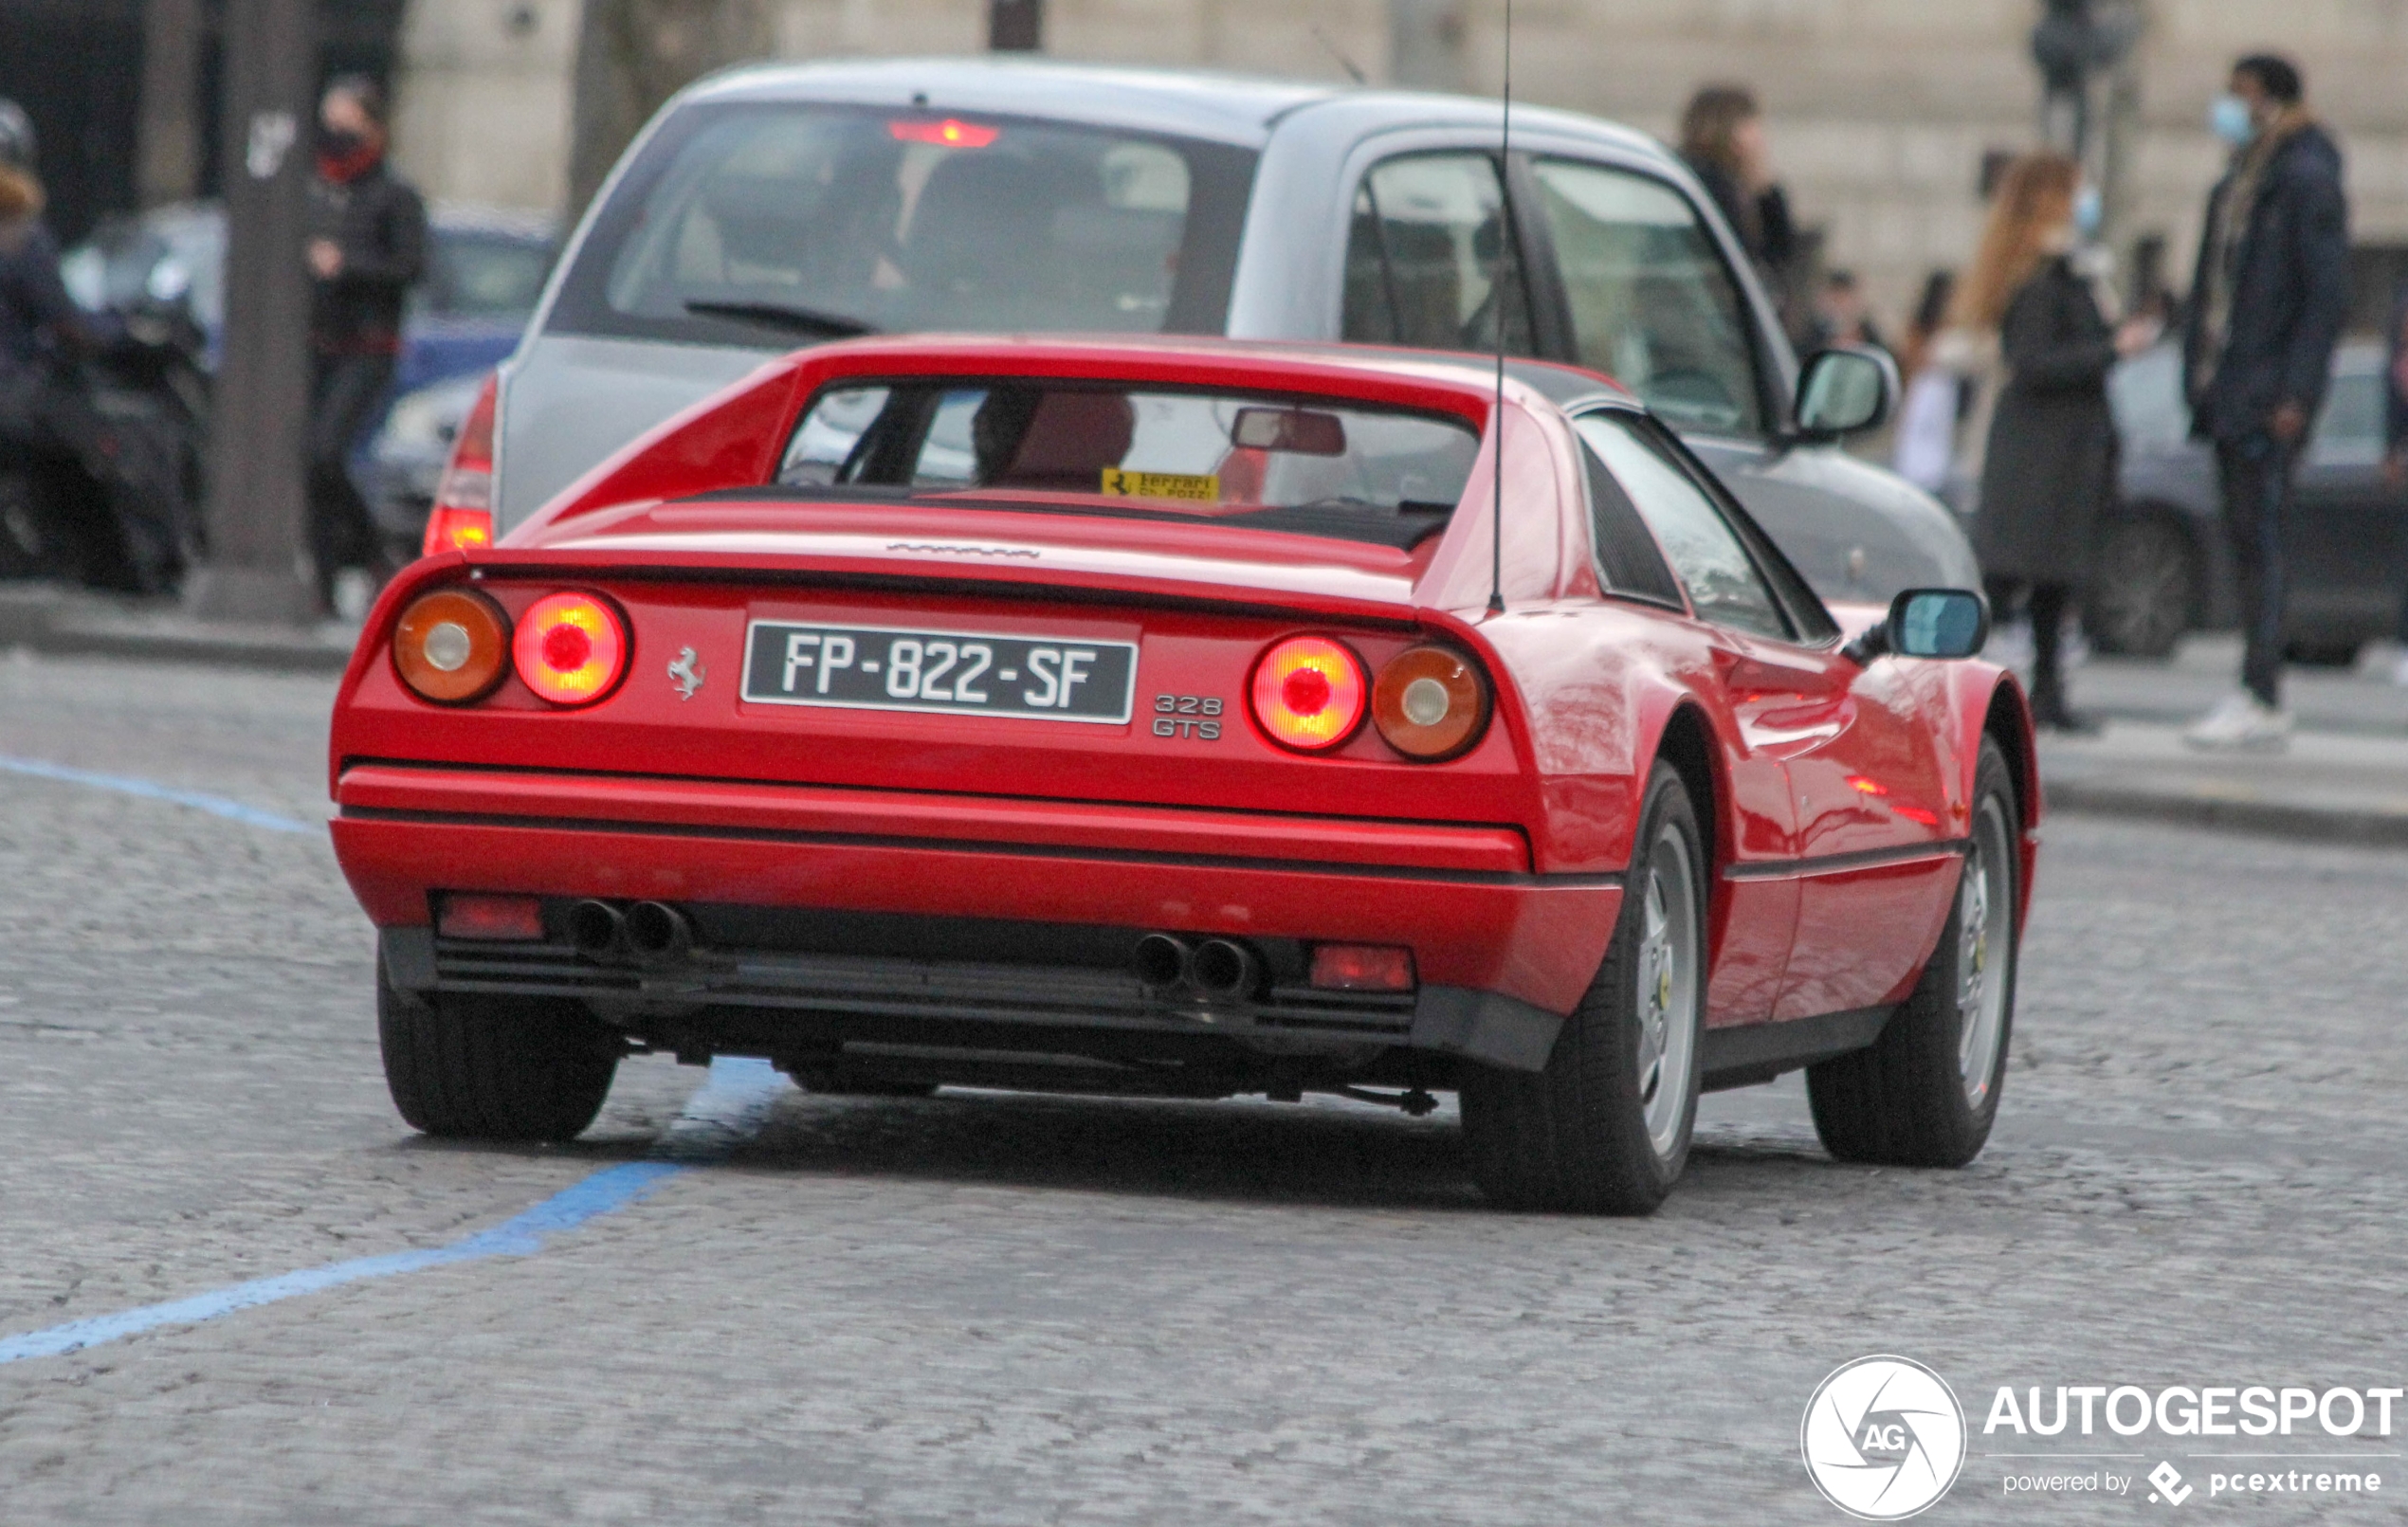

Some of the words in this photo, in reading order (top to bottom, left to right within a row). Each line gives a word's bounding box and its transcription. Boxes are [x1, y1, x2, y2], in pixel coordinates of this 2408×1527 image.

[782, 634, 1097, 709] FP-822-SF
[1155, 694, 1223, 716] 328
[1153, 718, 1221, 739] GTS
